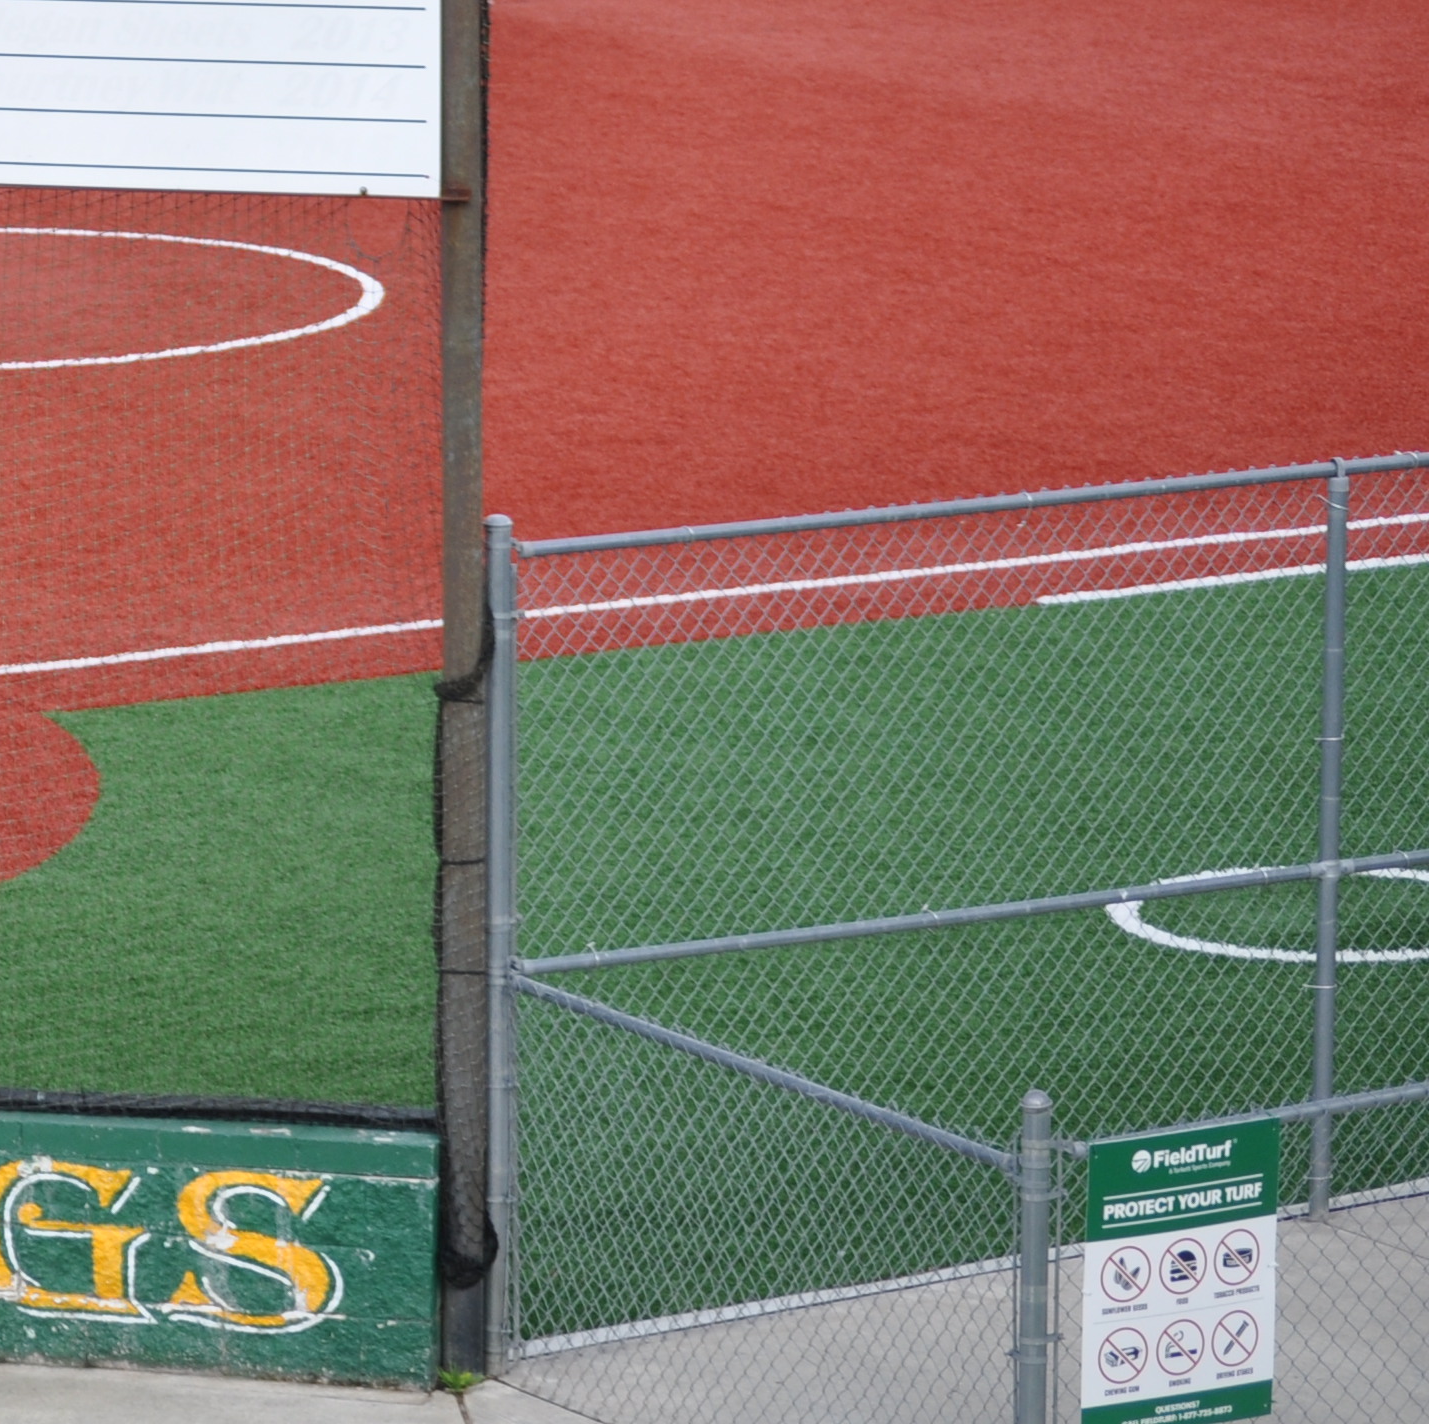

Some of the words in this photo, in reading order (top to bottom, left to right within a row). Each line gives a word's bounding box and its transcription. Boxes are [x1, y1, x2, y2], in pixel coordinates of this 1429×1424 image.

[1153, 1139, 1232, 1169] FieldTurf
[1103, 1196, 1175, 1221] PROTECT
[1178, 1188, 1222, 1210] YOUR
[1224, 1182, 1263, 1203] TURF
[1154, 1400, 1200, 1414] QUESTIONS?
